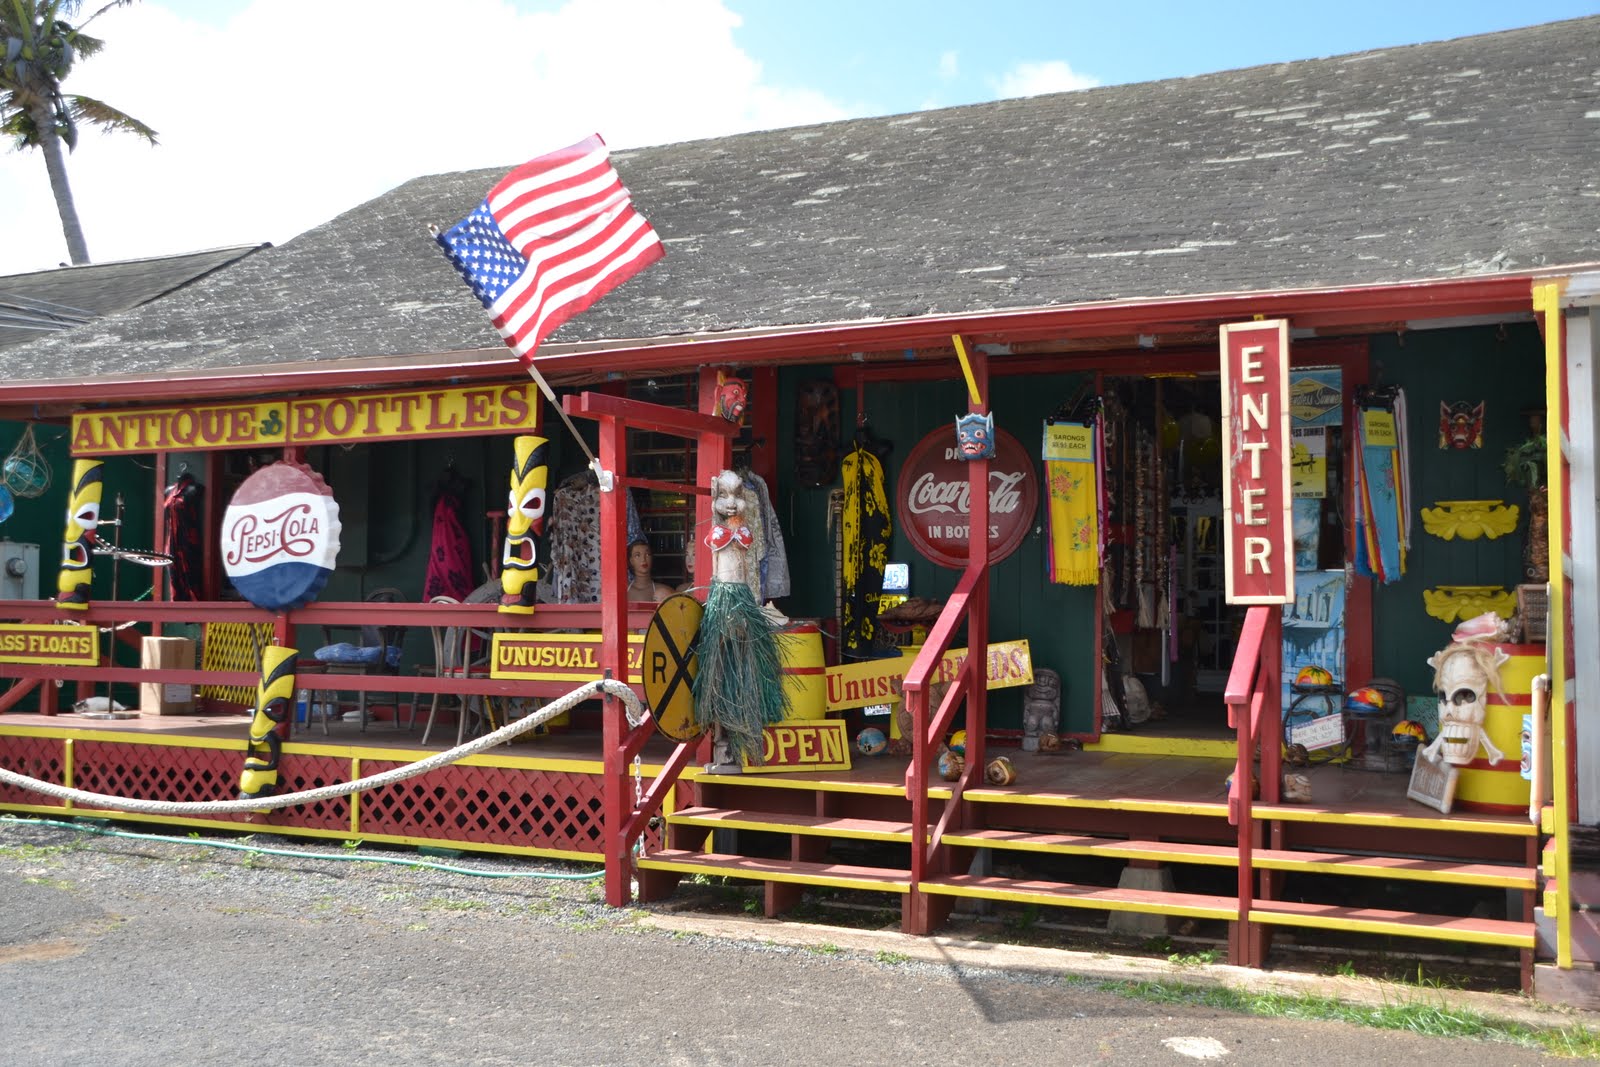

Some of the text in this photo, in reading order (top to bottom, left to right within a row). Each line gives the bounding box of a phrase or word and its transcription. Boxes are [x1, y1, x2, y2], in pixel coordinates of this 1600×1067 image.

[72, 385, 529, 450] ANTIQUE & BOTTLES
[1053, 433, 1086, 442] SARONGS
[1068, 442, 1087, 450] EACH
[1240, 345, 1272, 575] ENTER
[928, 526, 942, 539] IN
[28, 635, 91, 654] FLOATS
[499, 646, 599, 668] UNUSUAL
